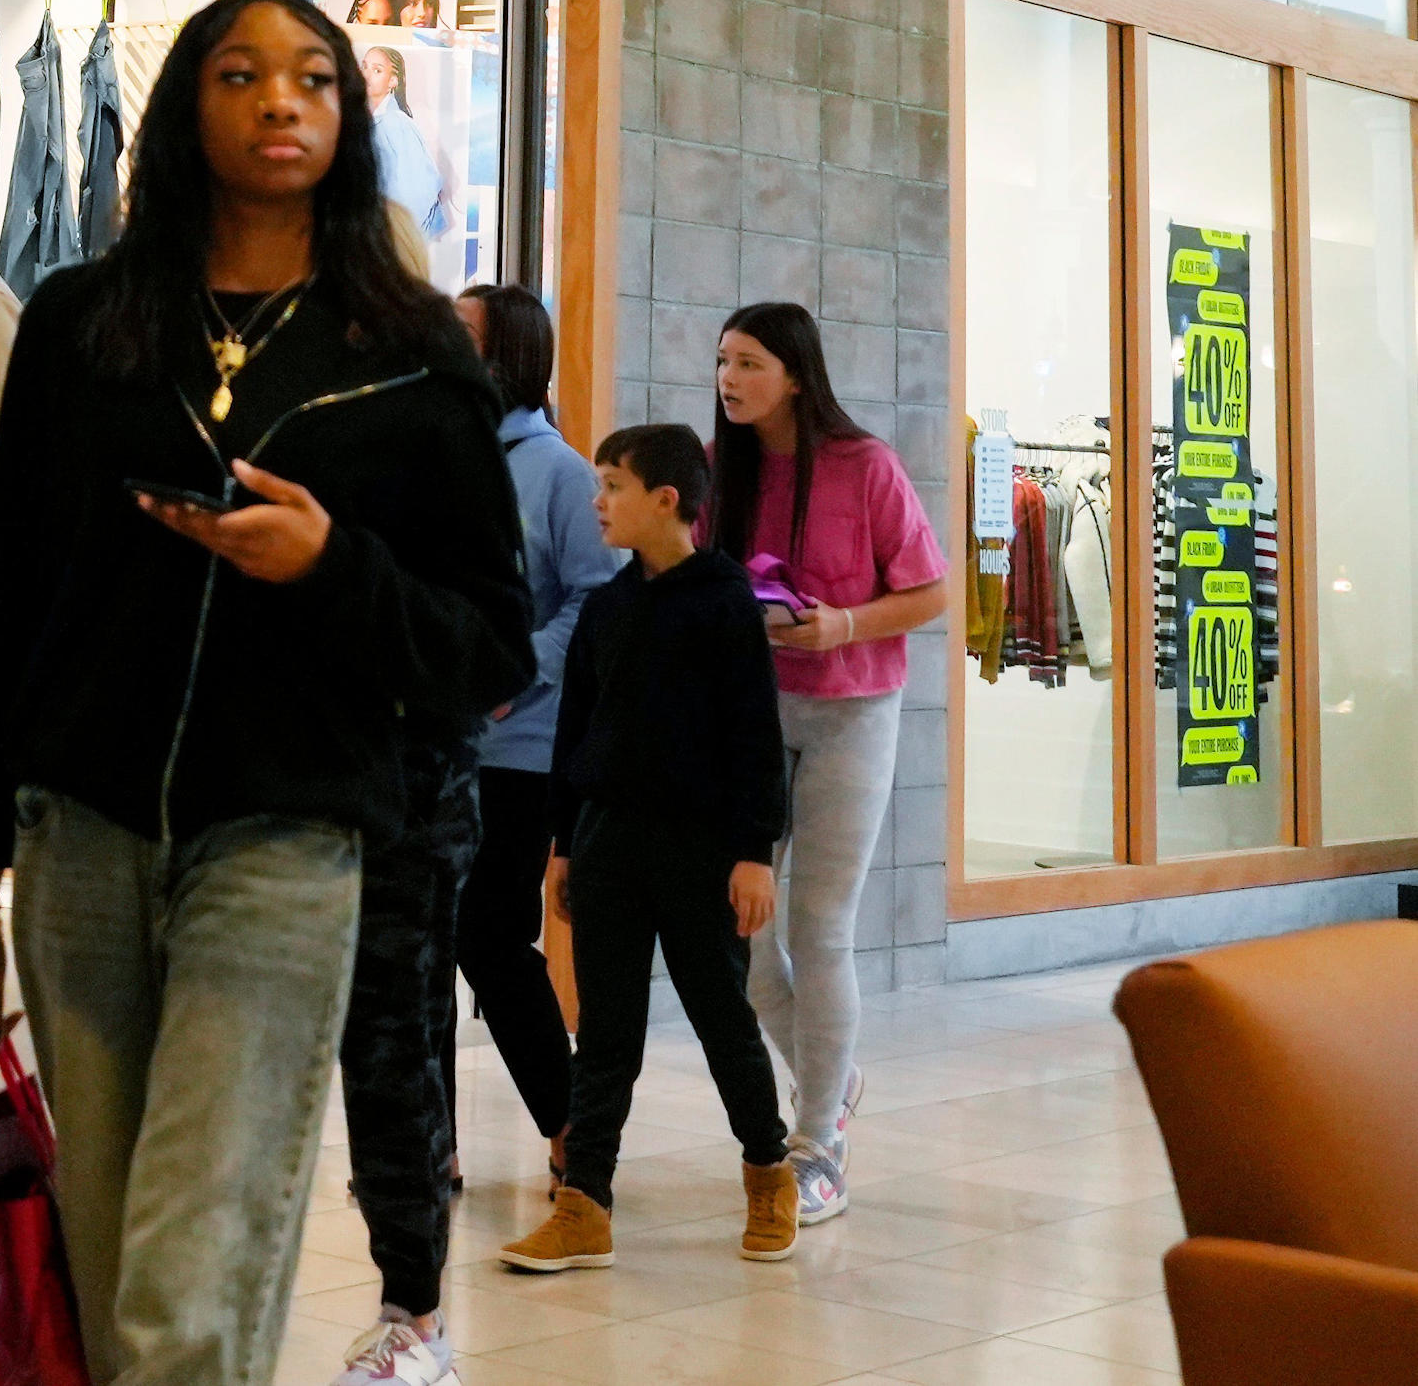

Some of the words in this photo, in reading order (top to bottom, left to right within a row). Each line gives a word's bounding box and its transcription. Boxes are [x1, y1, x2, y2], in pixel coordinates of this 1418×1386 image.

[1188, 334, 1242, 427] 40%
[980, 407, 1009, 433] STORE
[1224, 402, 1242, 428] OFF
[979, 548, 1011, 575] HOURS
[1193, 617, 1247, 711] 40%
[1229, 683, 1248, 710] OFF
